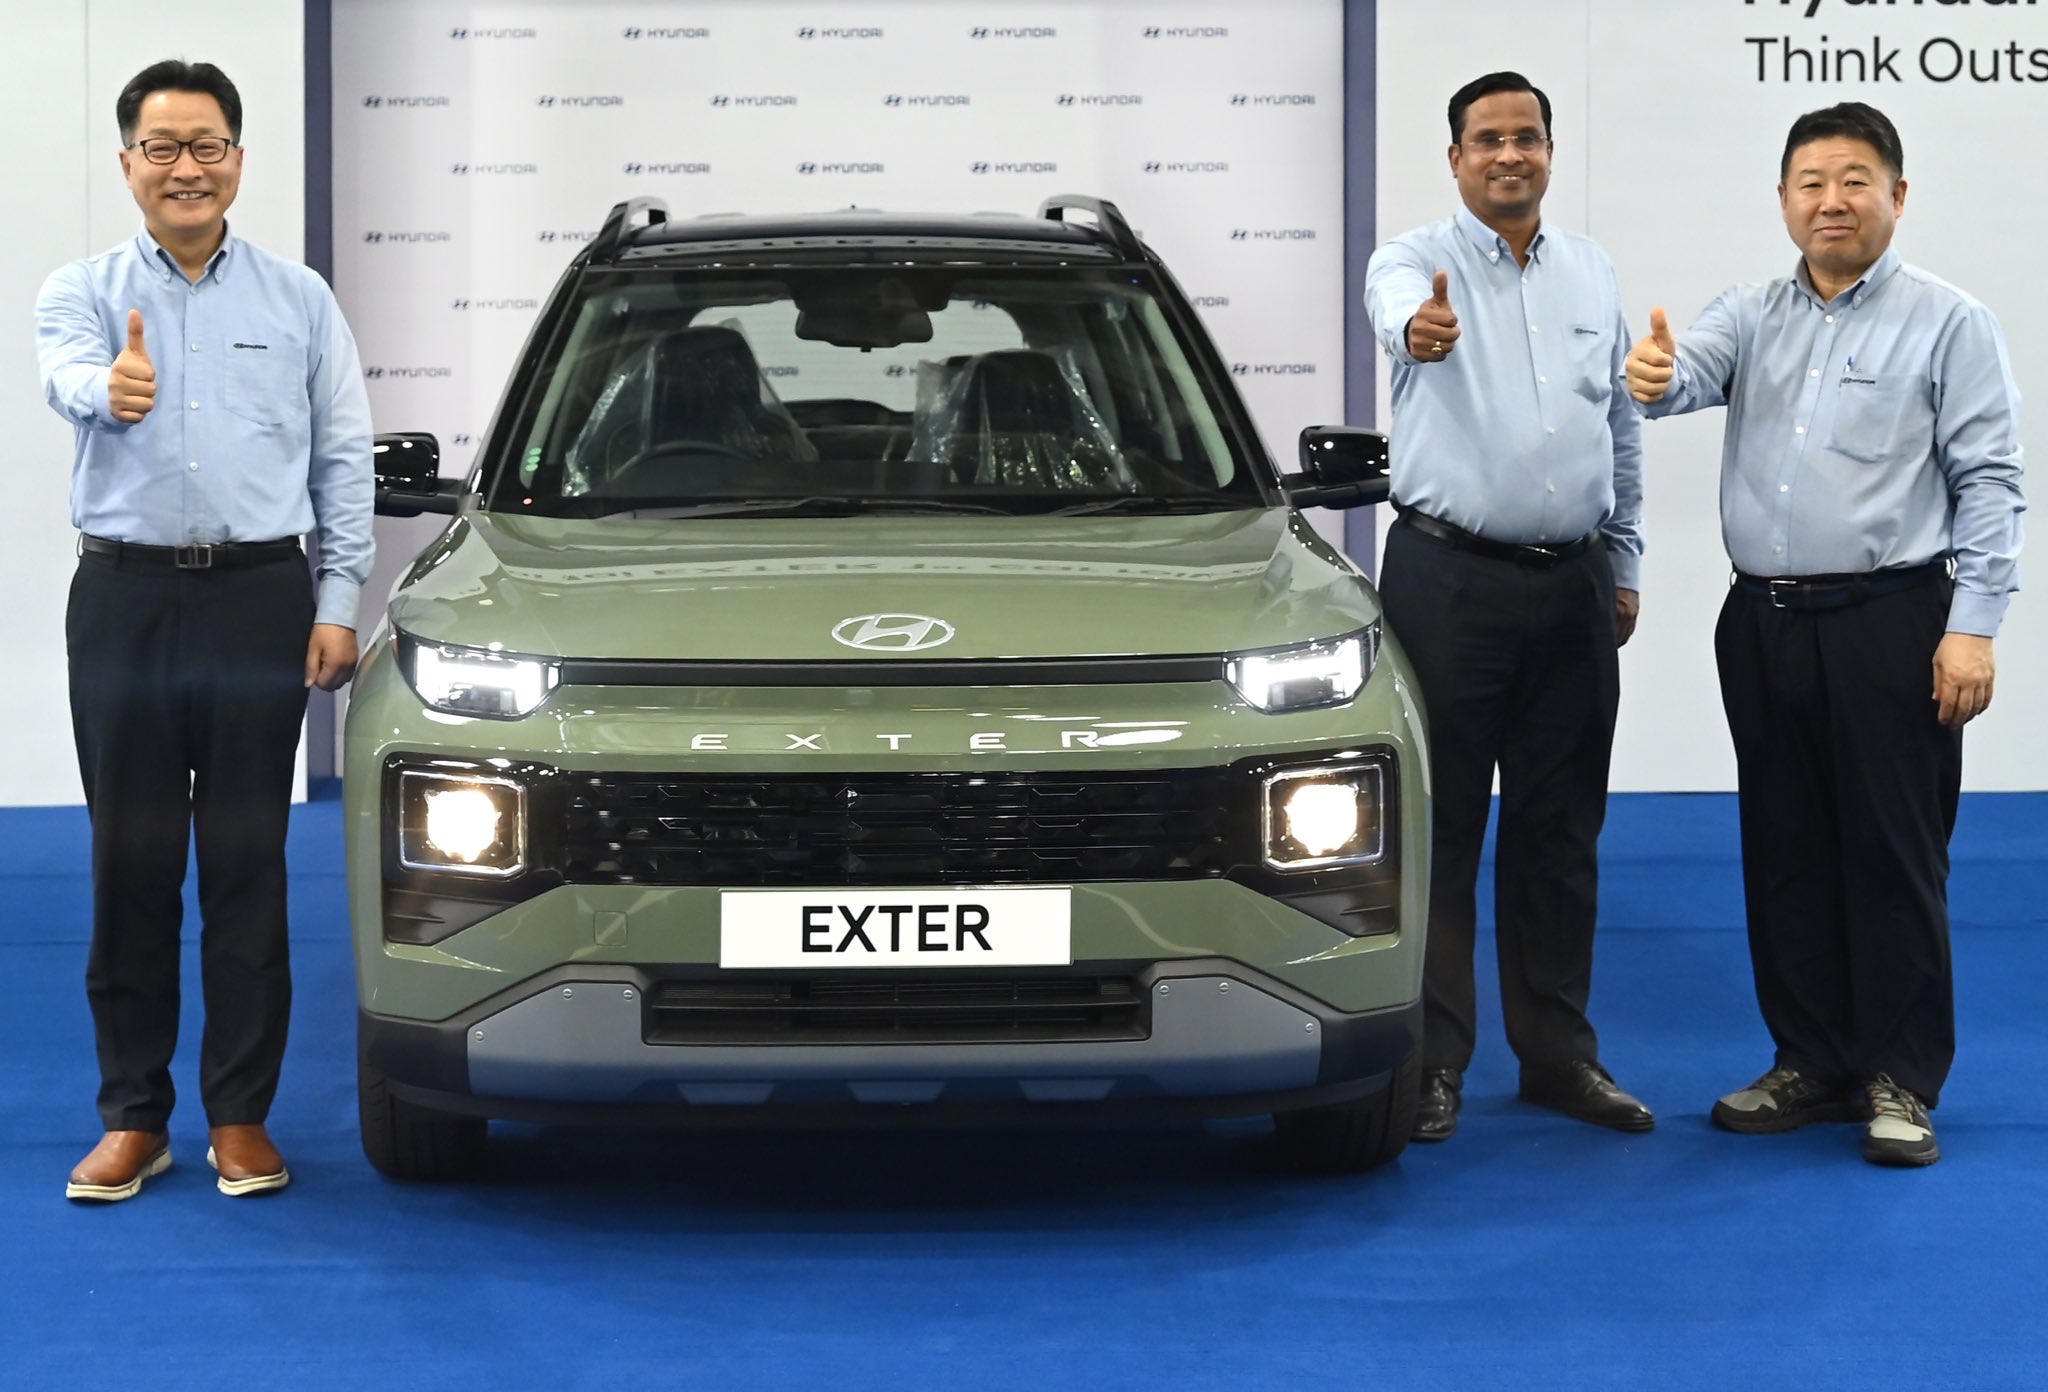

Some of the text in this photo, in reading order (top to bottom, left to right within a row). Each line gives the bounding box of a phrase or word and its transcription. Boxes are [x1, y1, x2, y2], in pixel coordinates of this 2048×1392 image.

[474, 27, 536, 40] HYUNDAI
[648, 27, 710, 39] HYUNDAI
[821, 27, 883, 39] HYUNDAI
[994, 27, 1056, 39] HYUNDAI
[1166, 26, 1228, 38] HYUNDAI
[1745, 35, 2048, 82] Think Outs
[387, 96, 450, 108] HYUNDAI
[561, 95, 623, 108] HYUNDAI
[735, 95, 797, 107] HYUNDAI
[908, 95, 970, 107] HYUNDAI
[1081, 94, 1142, 107] HYUNDAI
[1254, 94, 1315, 106] HYUNDAI
[475, 163, 537, 175] HYUNDAI
[648, 162, 710, 175] HYUNDAI
[822, 162, 884, 175] HYUNDAI
[995, 162, 1057, 174] HYUNDAI
[1167, 161, 1229, 173] HYUNDAI
[388, 231, 450, 243] HYUNDAI
[1254, 229, 1316, 241] HYUNDAI
[476, 298, 538, 310] HYUNDAI
[1192, 295, 1229, 308] NDAI
[389, 367, 451, 379] HYUNDAI
[1254, 363, 1316, 375] HYUNDAI
[691, 731, 1099, 750] EXTER
[802, 904, 993, 953] EXTER
